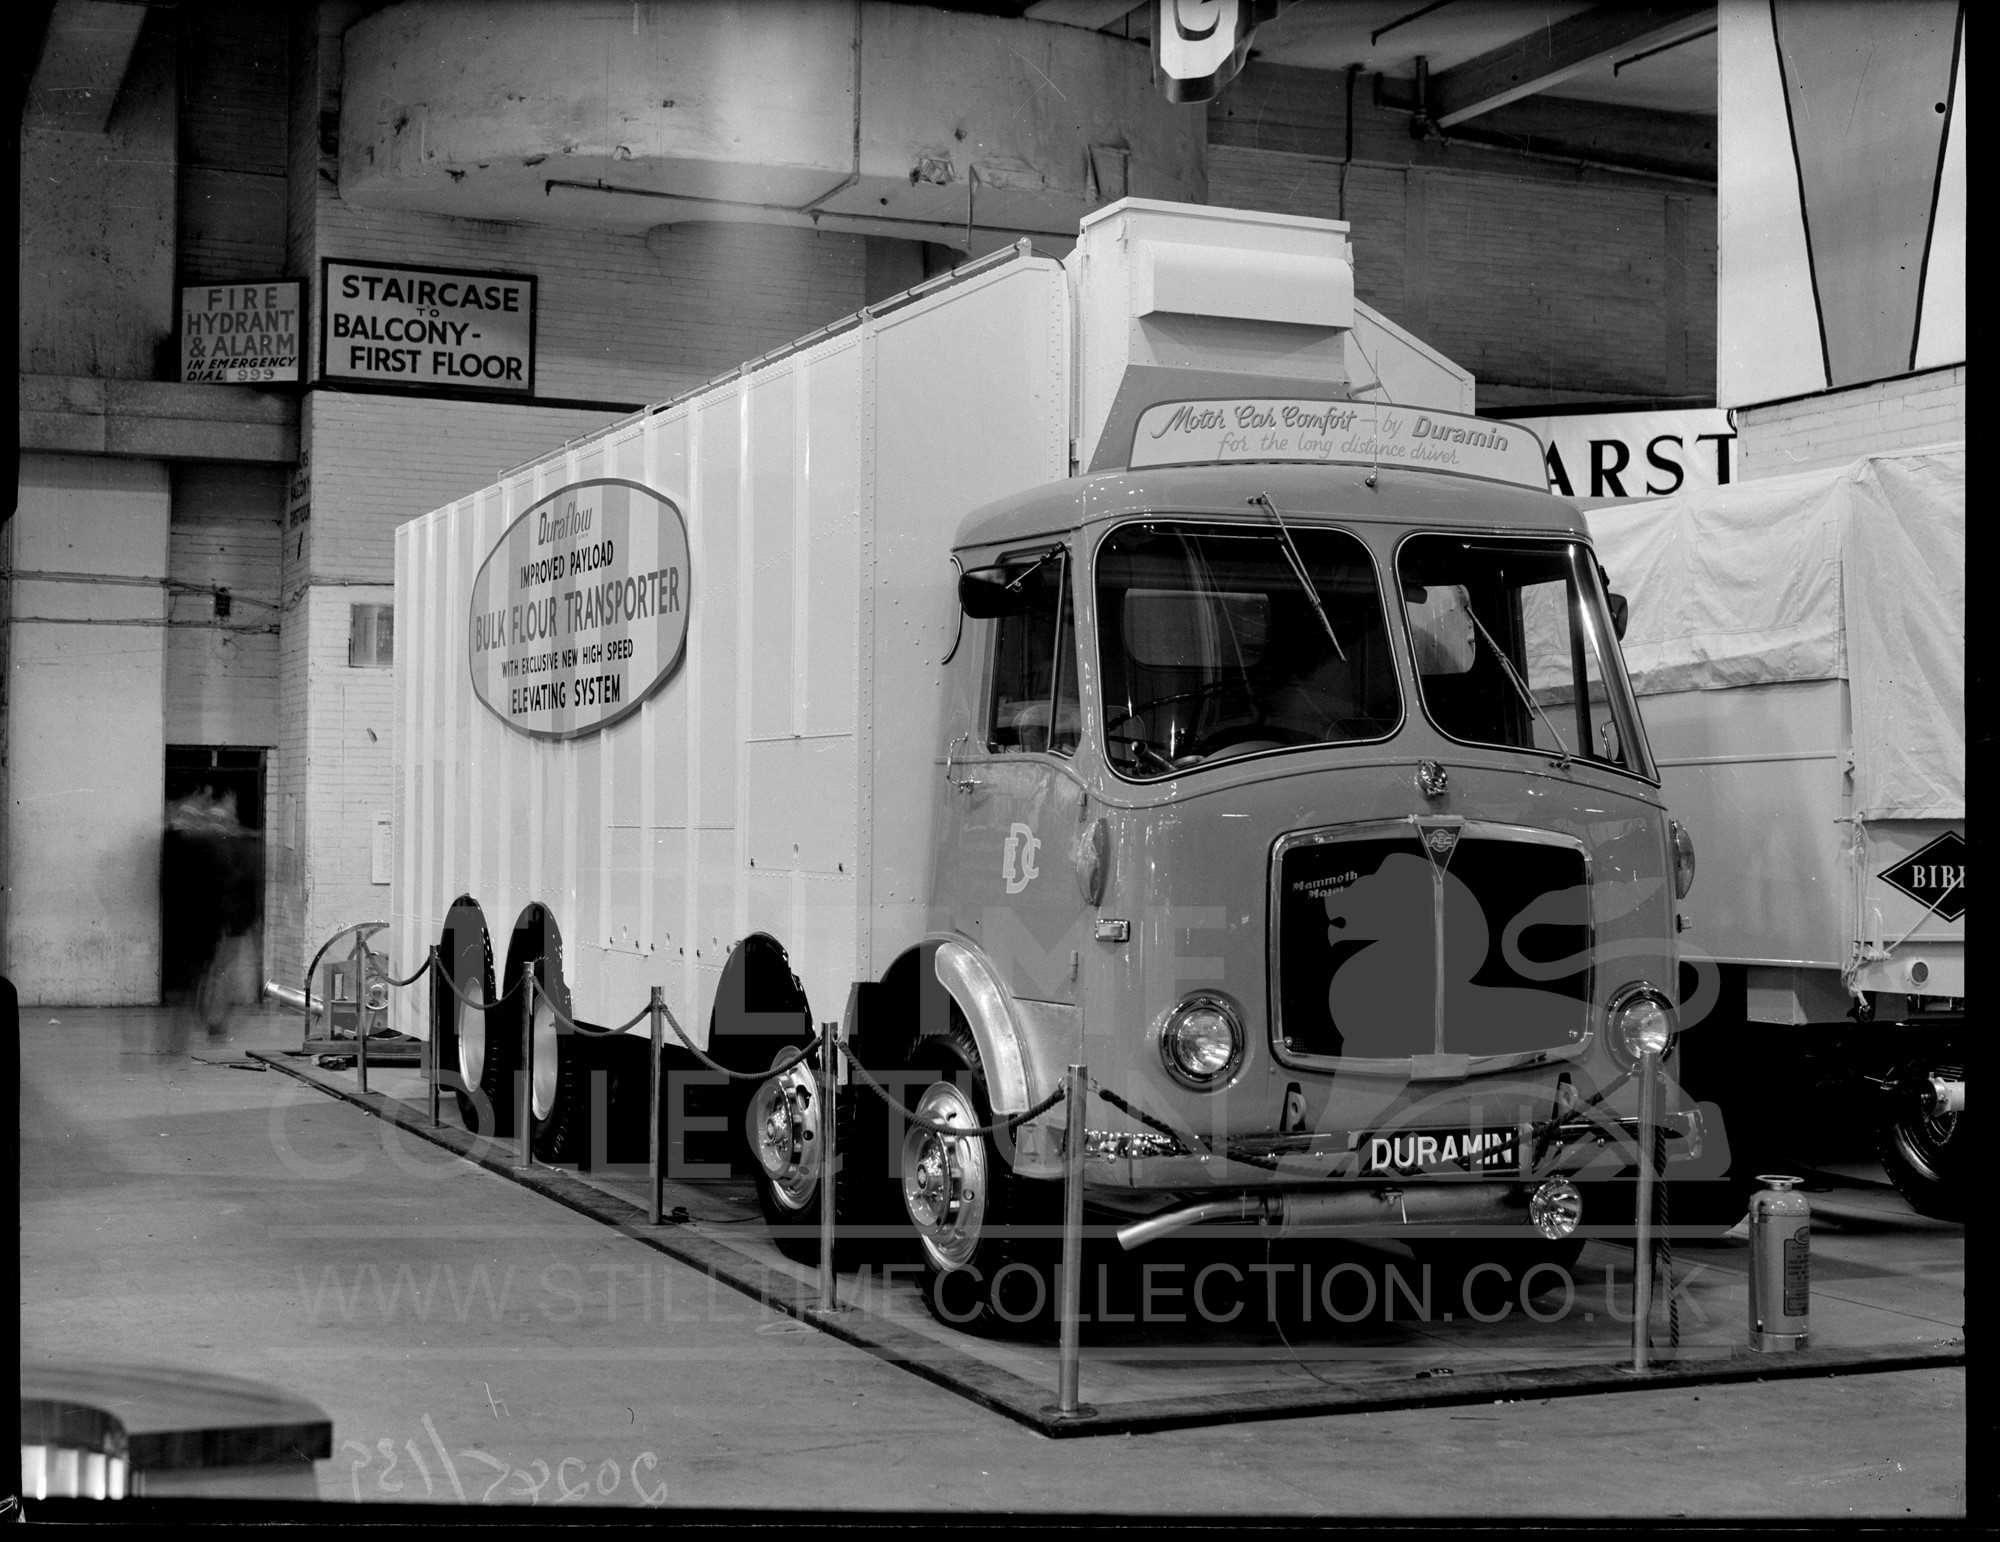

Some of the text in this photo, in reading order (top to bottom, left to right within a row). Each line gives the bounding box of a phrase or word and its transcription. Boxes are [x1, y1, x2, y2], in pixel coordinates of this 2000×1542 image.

[208, 287, 277, 311] FIRE
[342, 274, 520, 312] STAIRCASE
[187, 310, 295, 335] HYDRANT
[416, 307, 440, 318] TO
[187, 357, 297, 370] IN EMERGENCY
[190, 333, 295, 358] & ALARM
[350, 345, 522, 381] FIRST FLOOR
[187, 368, 275, 381] DIAL 999
[1151, 406, 1226, 439] Motor
[1235, 406, 1277, 429] Car
[1282, 406, 1357, 436] Comfort
[1382, 411, 1404, 439] by
[1412, 415, 1509, 451] Duramin
[1217, 431, 1461, 464] for the long distance driver
[538, 501, 593, 546] Duraflow
[520, 540, 614, 589] IMPROVED PAYLOAD
[475, 566, 680, 653] BULK FLOUR TRANSPORTER
[502, 638, 633, 678] WITH EXCLUSIVE NEW HIGH SPEED
[512, 674, 621, 714] ELEVATING SYSTEM
[1293, 872, 1358, 894] Mammoth
[1371, 1132, 1513, 1170] DURAMIN
